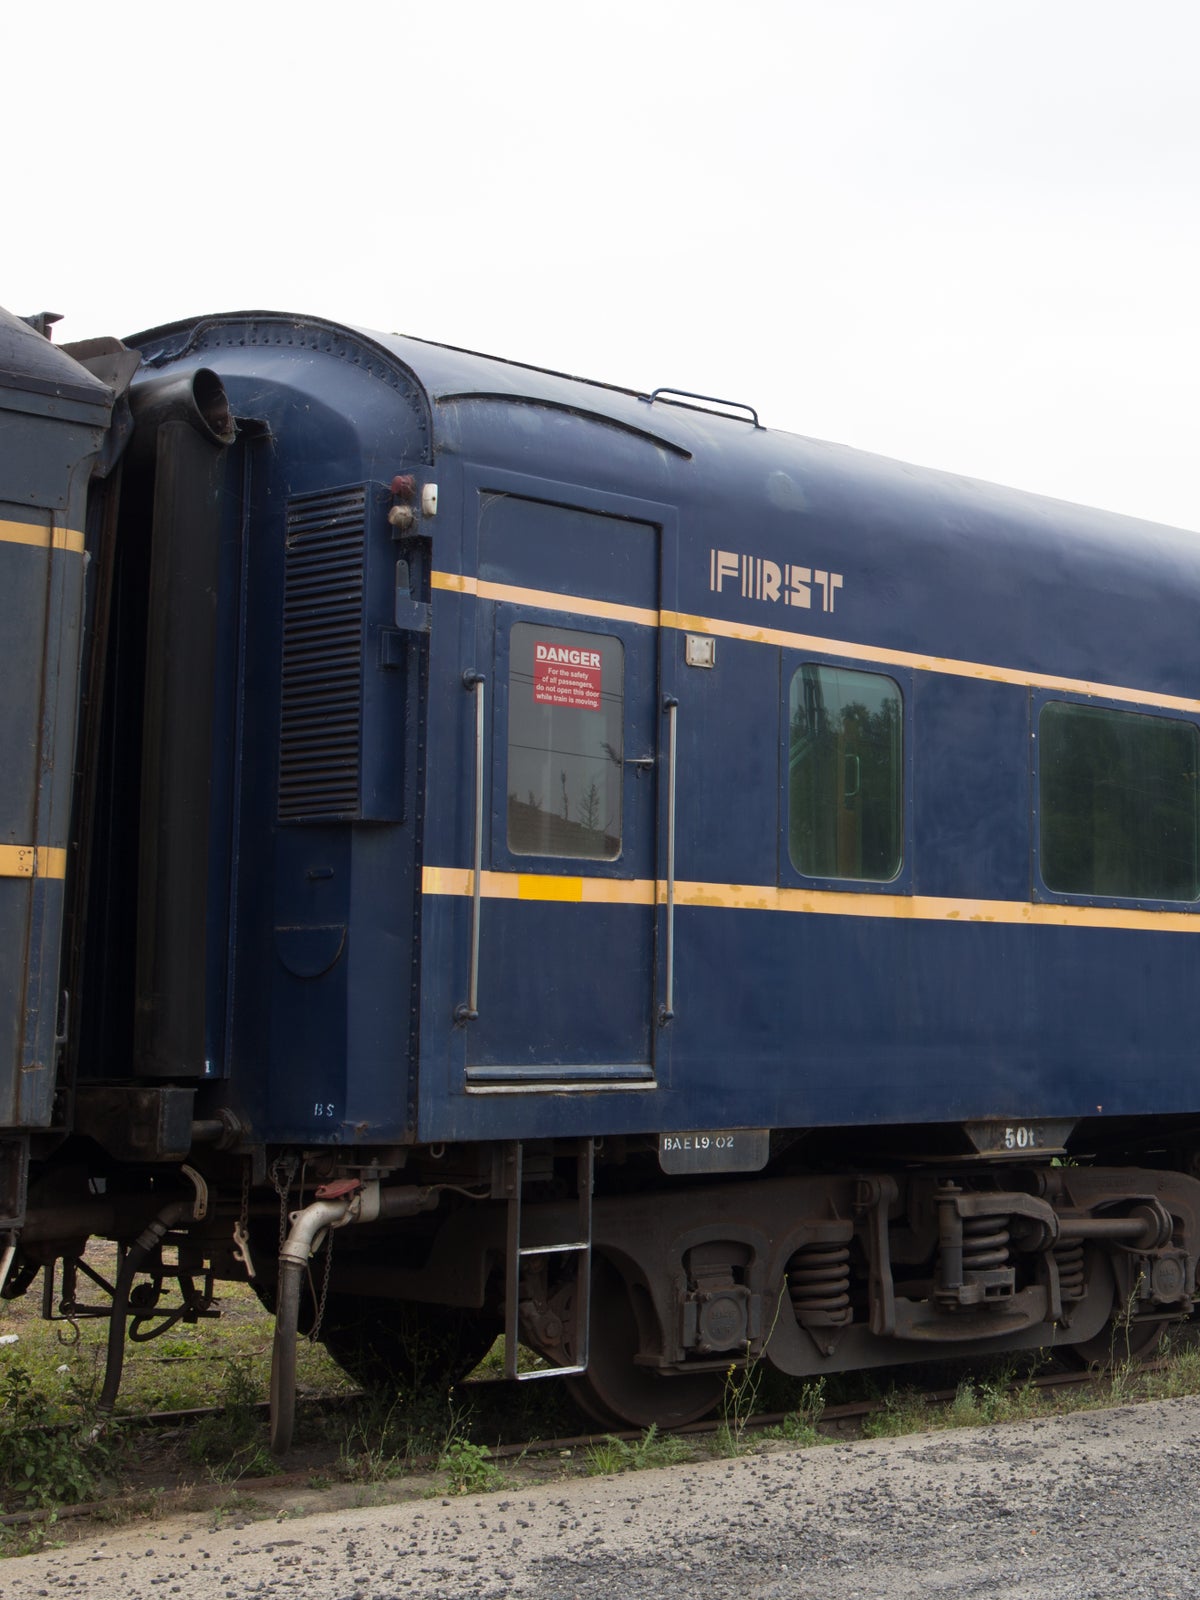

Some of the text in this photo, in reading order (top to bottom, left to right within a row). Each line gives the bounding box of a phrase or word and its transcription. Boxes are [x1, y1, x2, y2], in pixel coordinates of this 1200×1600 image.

[710, 548, 843, 613] FIRST
[536, 645, 601, 667] DANGER
[548, 667, 559, 675] For
[571, 671, 589, 680] safety
[557, 687, 572, 695] open
